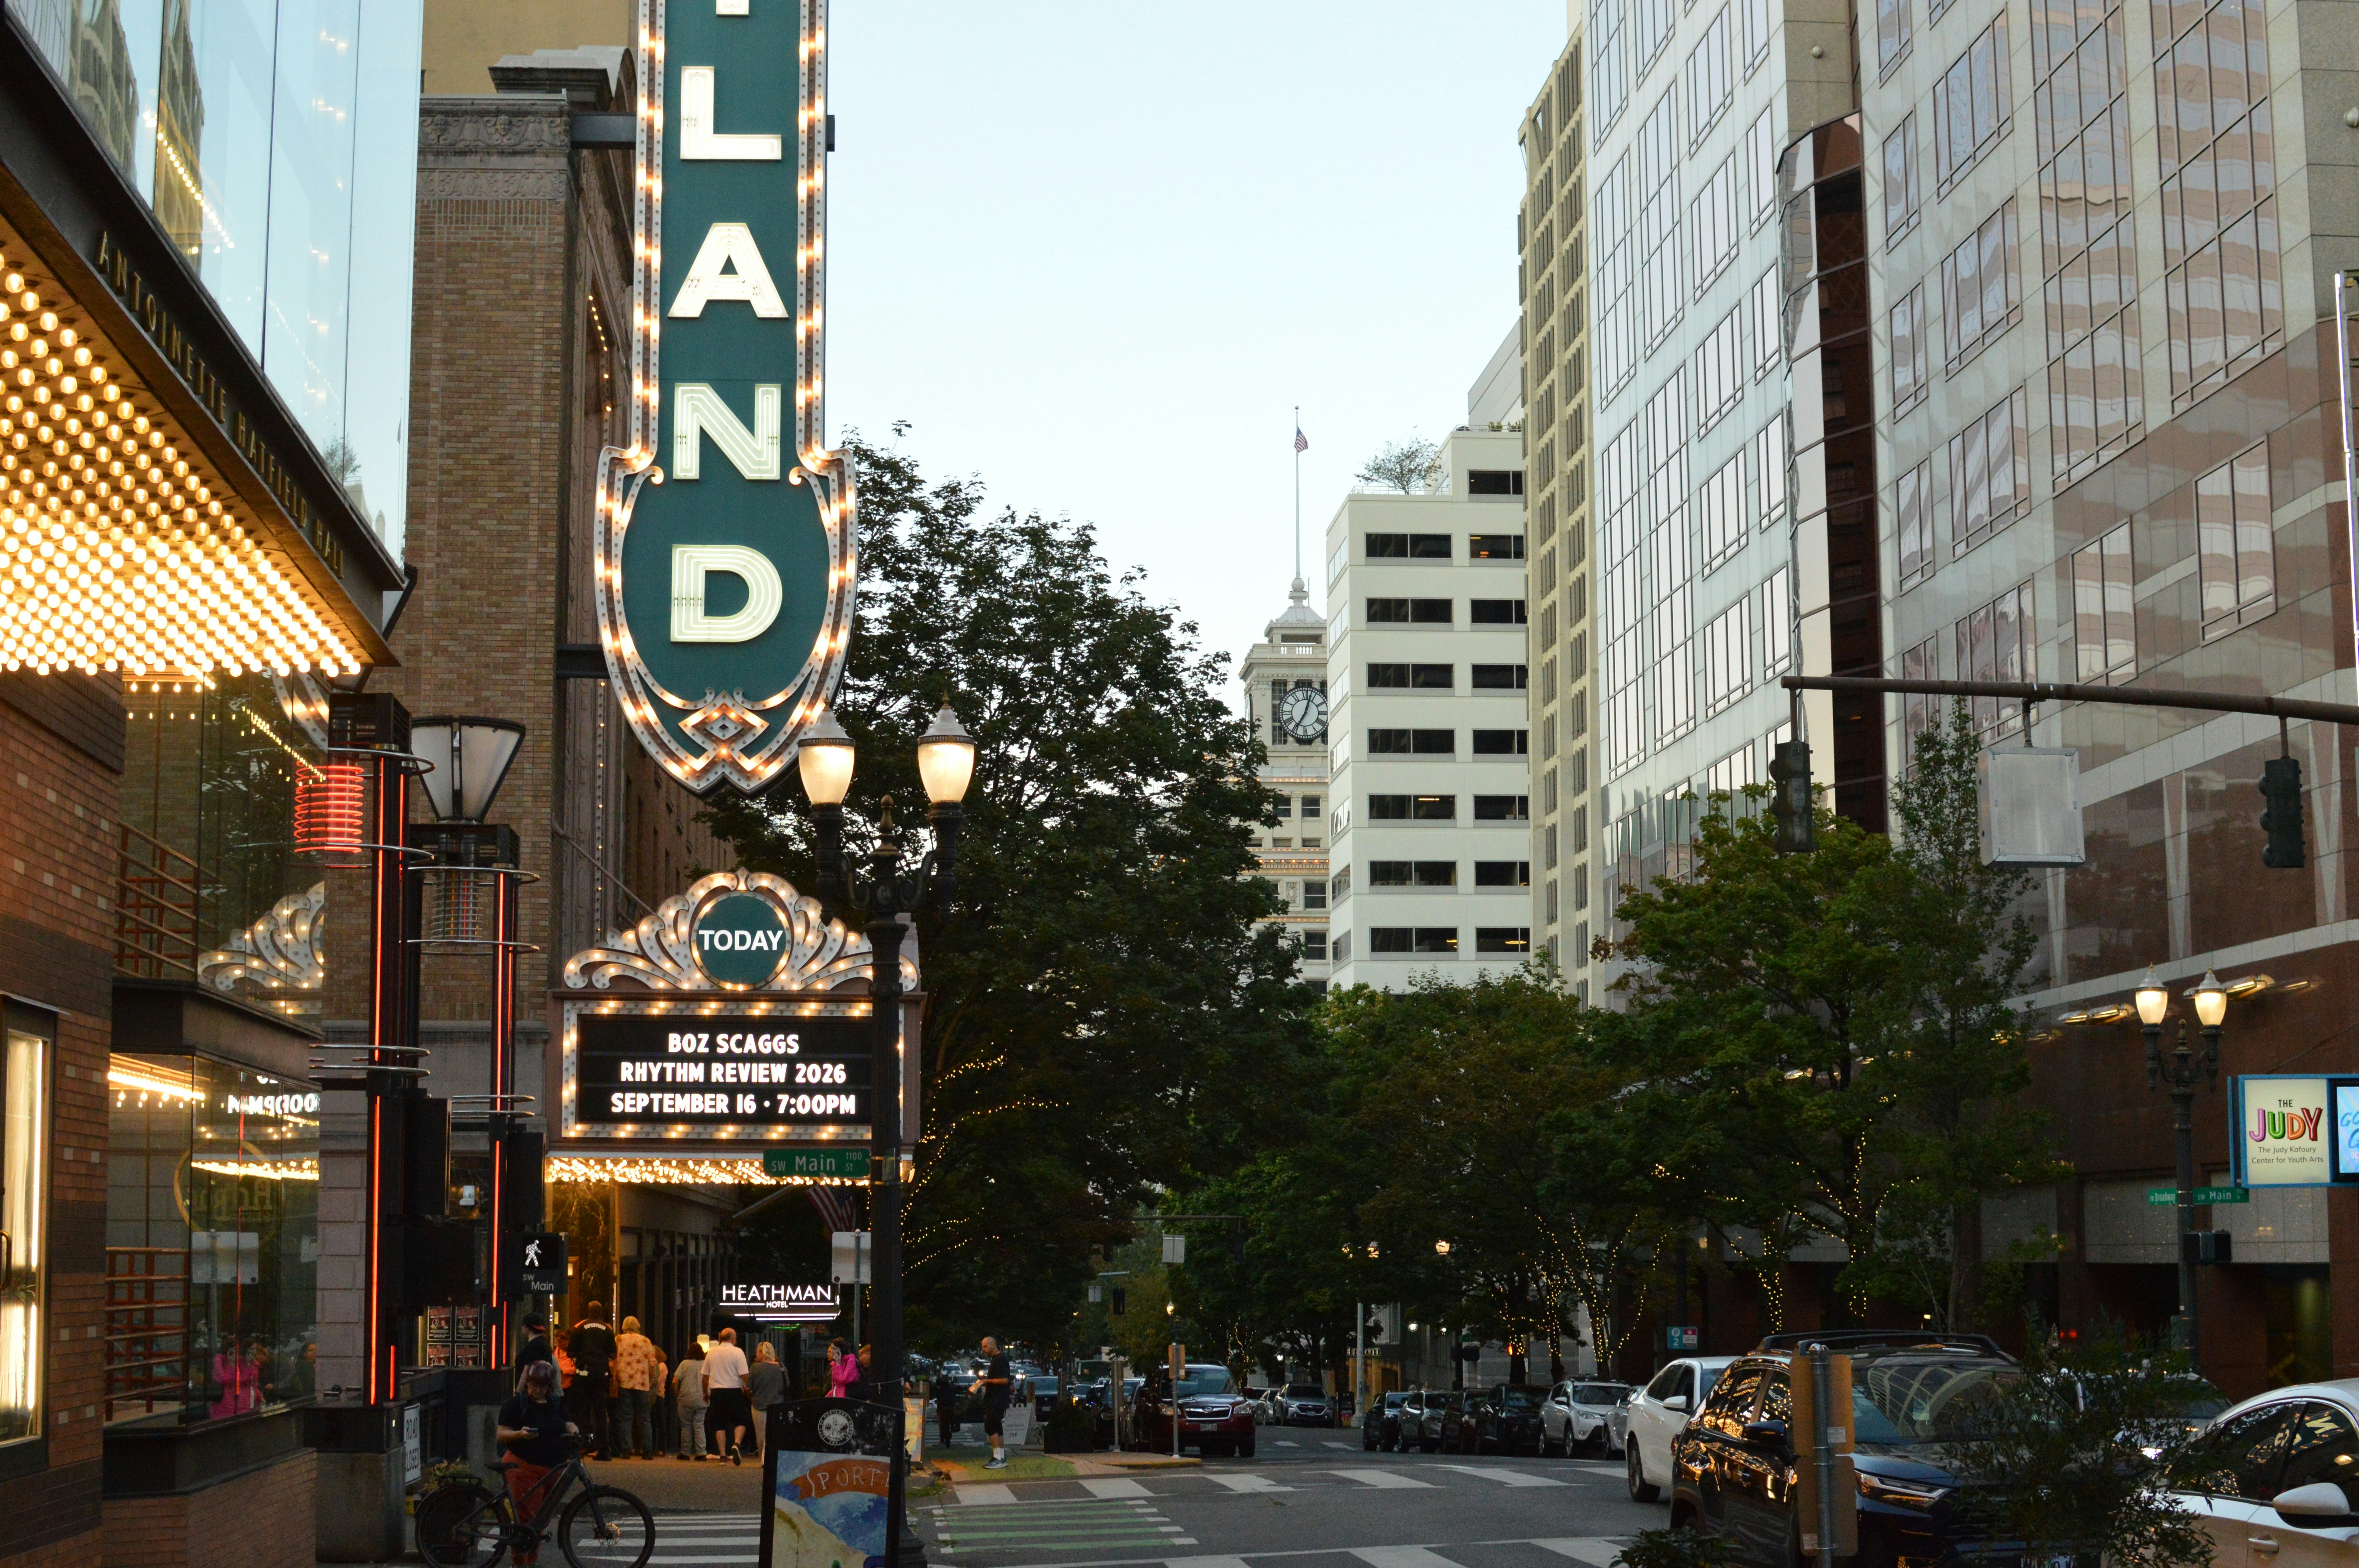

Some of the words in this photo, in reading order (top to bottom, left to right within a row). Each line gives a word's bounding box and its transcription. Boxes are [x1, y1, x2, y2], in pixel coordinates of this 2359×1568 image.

[667, 0, 789, 643] LAND
[96, 229, 226, 425] ANTOINETTE
[234, 411, 307, 529] HATFIELD
[314, 518, 344, 579] HALL
[698, 929, 783, 951] TODAY
[669, 1033, 709, 1053] BOZ
[716, 1034, 799, 1054] SCAGGS
[621, 1062, 704, 1082] RHYTHM
[711, 1063, 787, 1082] REVIEW
[795, 1063, 846, 1083] 2026
[612, 1093, 729, 1113] SEPTEMBER
[737, 1094, 756, 1114] 16
[777, 1094, 856, 1115] 7:00PM
[2249, 1107, 2323, 1142] JUDY
[772, 1160, 786, 1171] SW
[795, 1154, 835, 1171] Main
[846, 1152, 862, 1160] 1100
[846, 1163, 854, 1171] St
[2155, 1192, 2176, 1203] Broadway
[2209, 1190, 2232, 1200] Main
[531, 1281, 554, 1291] Main
[723, 1285, 831, 1301] HEATHMAN
[1673, 1338, 1679, 1346] 2
[406, 1417, 418, 1441] ROAD
[406, 1447, 419, 1472] LOSED
